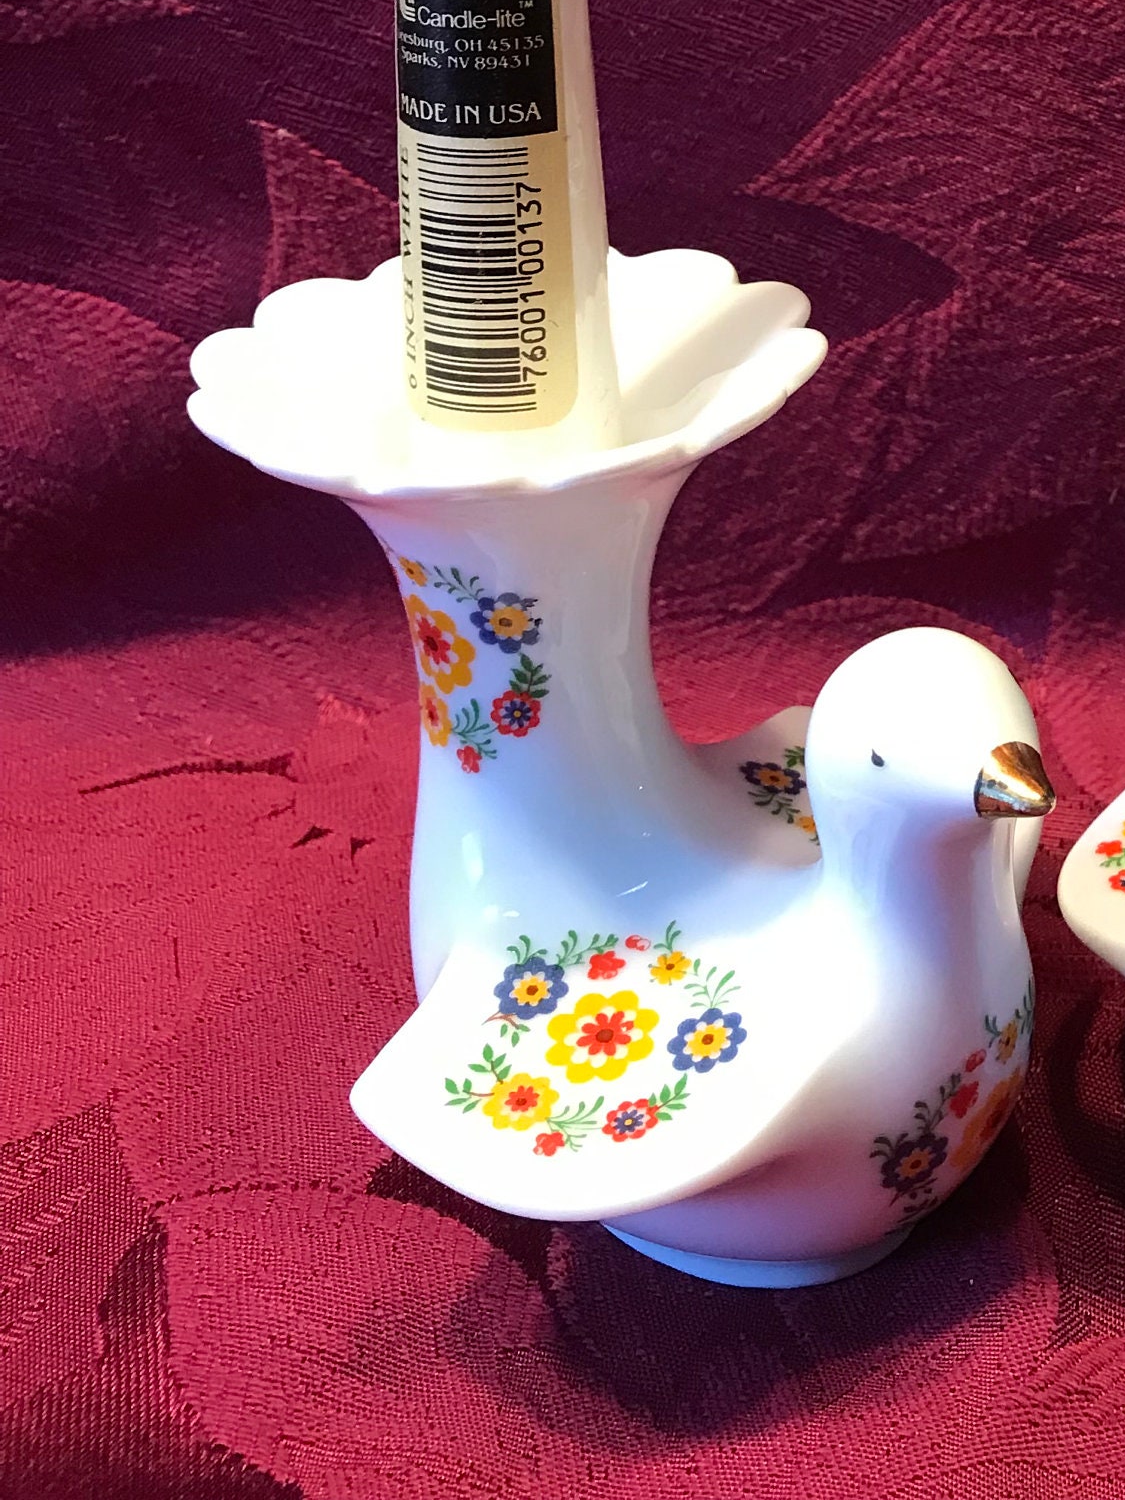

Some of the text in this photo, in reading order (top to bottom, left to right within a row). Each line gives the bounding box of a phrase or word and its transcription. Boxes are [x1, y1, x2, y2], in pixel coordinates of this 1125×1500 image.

[417, 5, 526, 29] Candle-lite
[454, 38, 483, 52] OH
[487, 34, 546, 51] 45135
[400, 46, 531, 70] Sparks, NV 89431
[400, 93, 543, 124] MADE IN USA
[400, 146, 413, 257] WHITE
[402, 276, 418, 363] INCH
